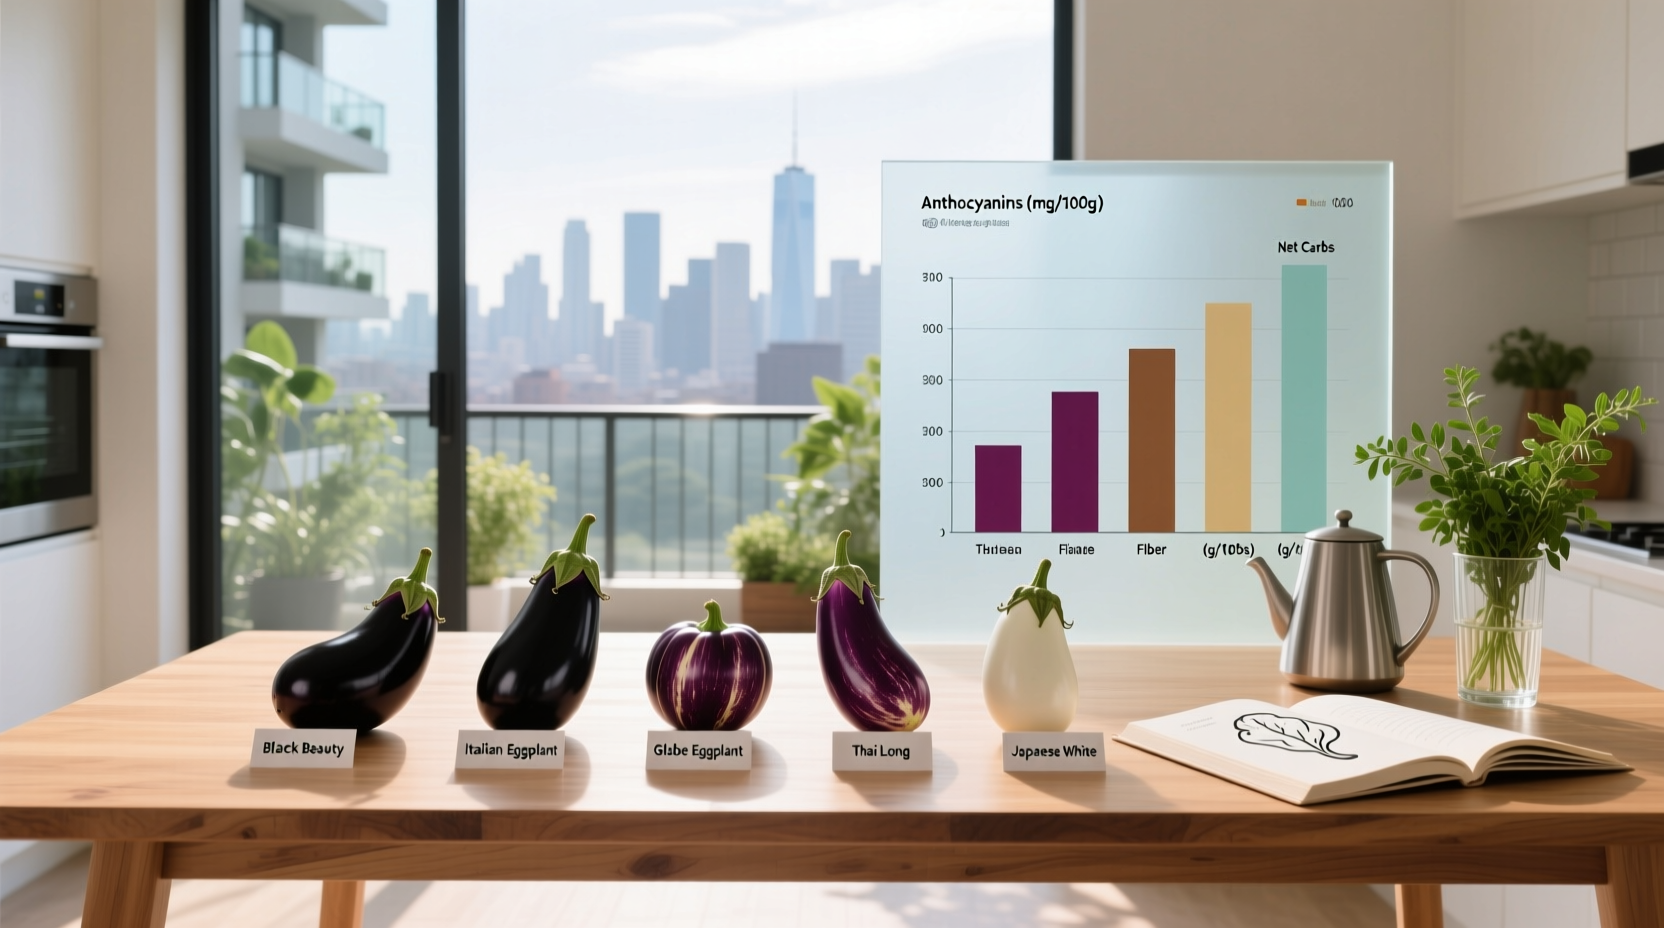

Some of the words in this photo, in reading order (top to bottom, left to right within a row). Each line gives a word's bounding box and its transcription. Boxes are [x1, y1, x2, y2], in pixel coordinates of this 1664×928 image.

[921, 194, 1023, 213] Anthocyanins
[1026, 194, 1104, 214] (mg/100g)
[1278, 241, 1298, 253] Net
[1301, 240, 1335, 253] Carbs
[263, 741, 299, 754] Black
[302, 742, 345, 758] Beauty
[465, 742, 503, 755] Italian
[507, 743, 557, 759] Eggplant
[692, 744, 743, 760] Eggplant
[852, 744, 877, 757] Thai
[880, 744, 910, 760] Long
[1063, 745, 1098, 757] White
